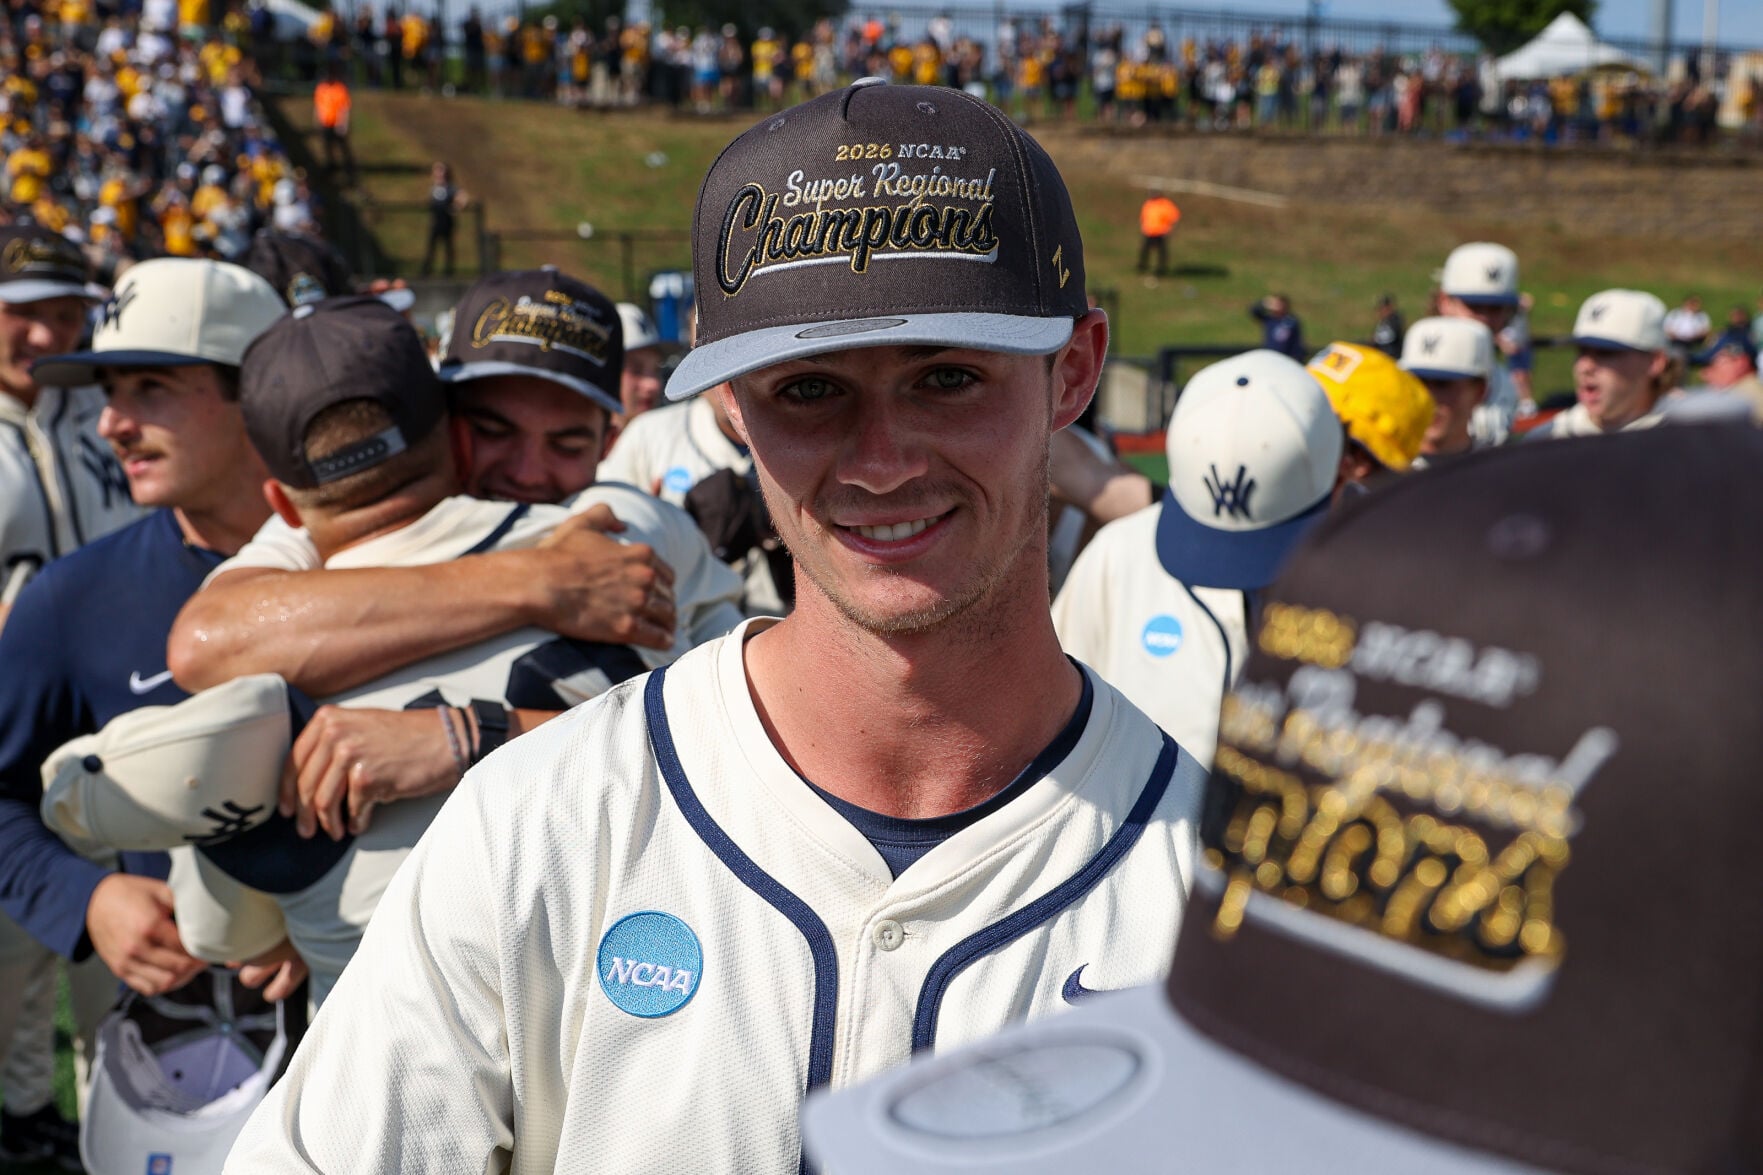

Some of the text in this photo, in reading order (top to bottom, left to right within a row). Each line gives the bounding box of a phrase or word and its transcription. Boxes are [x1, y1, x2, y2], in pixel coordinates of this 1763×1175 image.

[835, 143, 893, 161] 2026
[783, 162, 997, 213] Super Regional
[715, 182, 999, 297] Champions
[606, 957, 693, 996] NCAA
